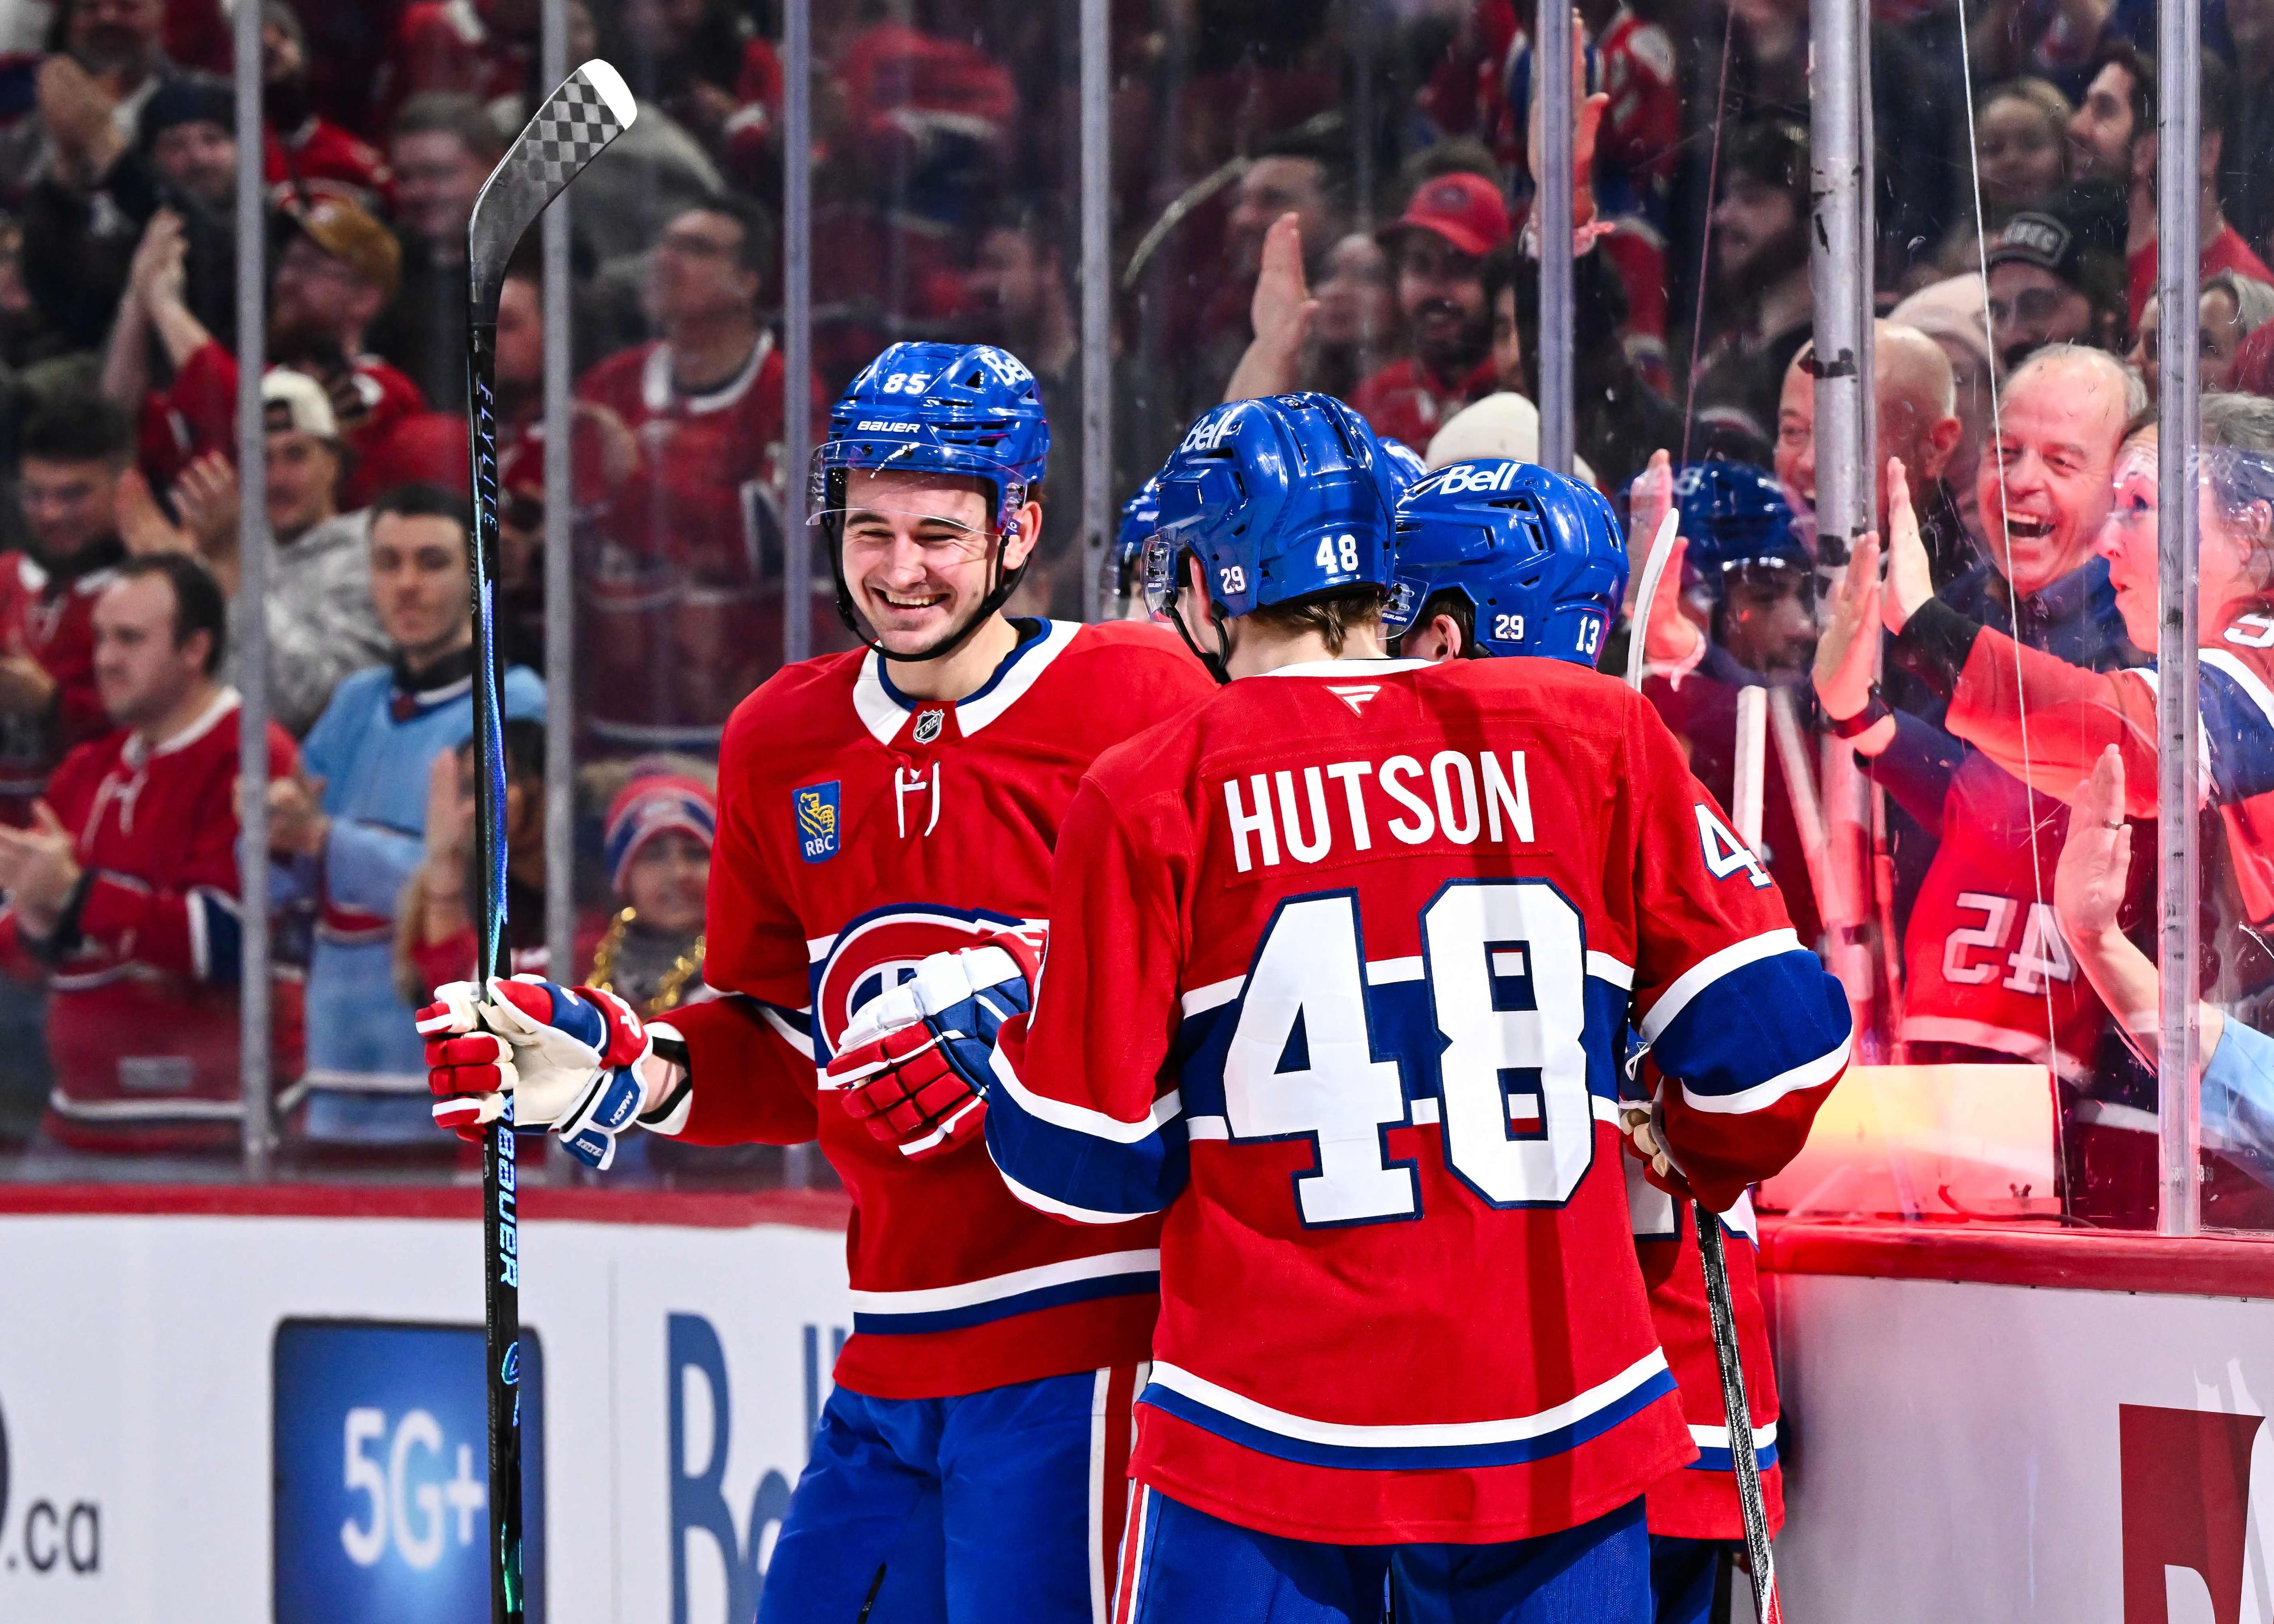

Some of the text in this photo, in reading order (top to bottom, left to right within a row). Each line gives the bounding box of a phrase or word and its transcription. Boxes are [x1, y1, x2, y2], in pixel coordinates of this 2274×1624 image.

[883, 373, 931, 395] 85
[857, 420, 921, 433] BAUER
[1180, 411, 1235, 453] Bell
[480, 382, 498, 532] FLYLITE
[1439, 463, 1521, 495] Bell
[1315, 534, 1358, 575] 48
[1220, 566, 1245, 593] 29
[1382, 613, 1408, 623] BAUER
[1495, 614, 1524, 640] 29
[1575, 615, 1600, 654] 13
[919, 716, 939, 736] LNH
[1223, 749, 1535, 873] HUTSON
[805, 835, 835, 857] RBC
[1223, 876, 1595, 1231] 48
[498, 1125, 518, 1287] BAUER
[341, 1407, 485, 1570] 5G+
